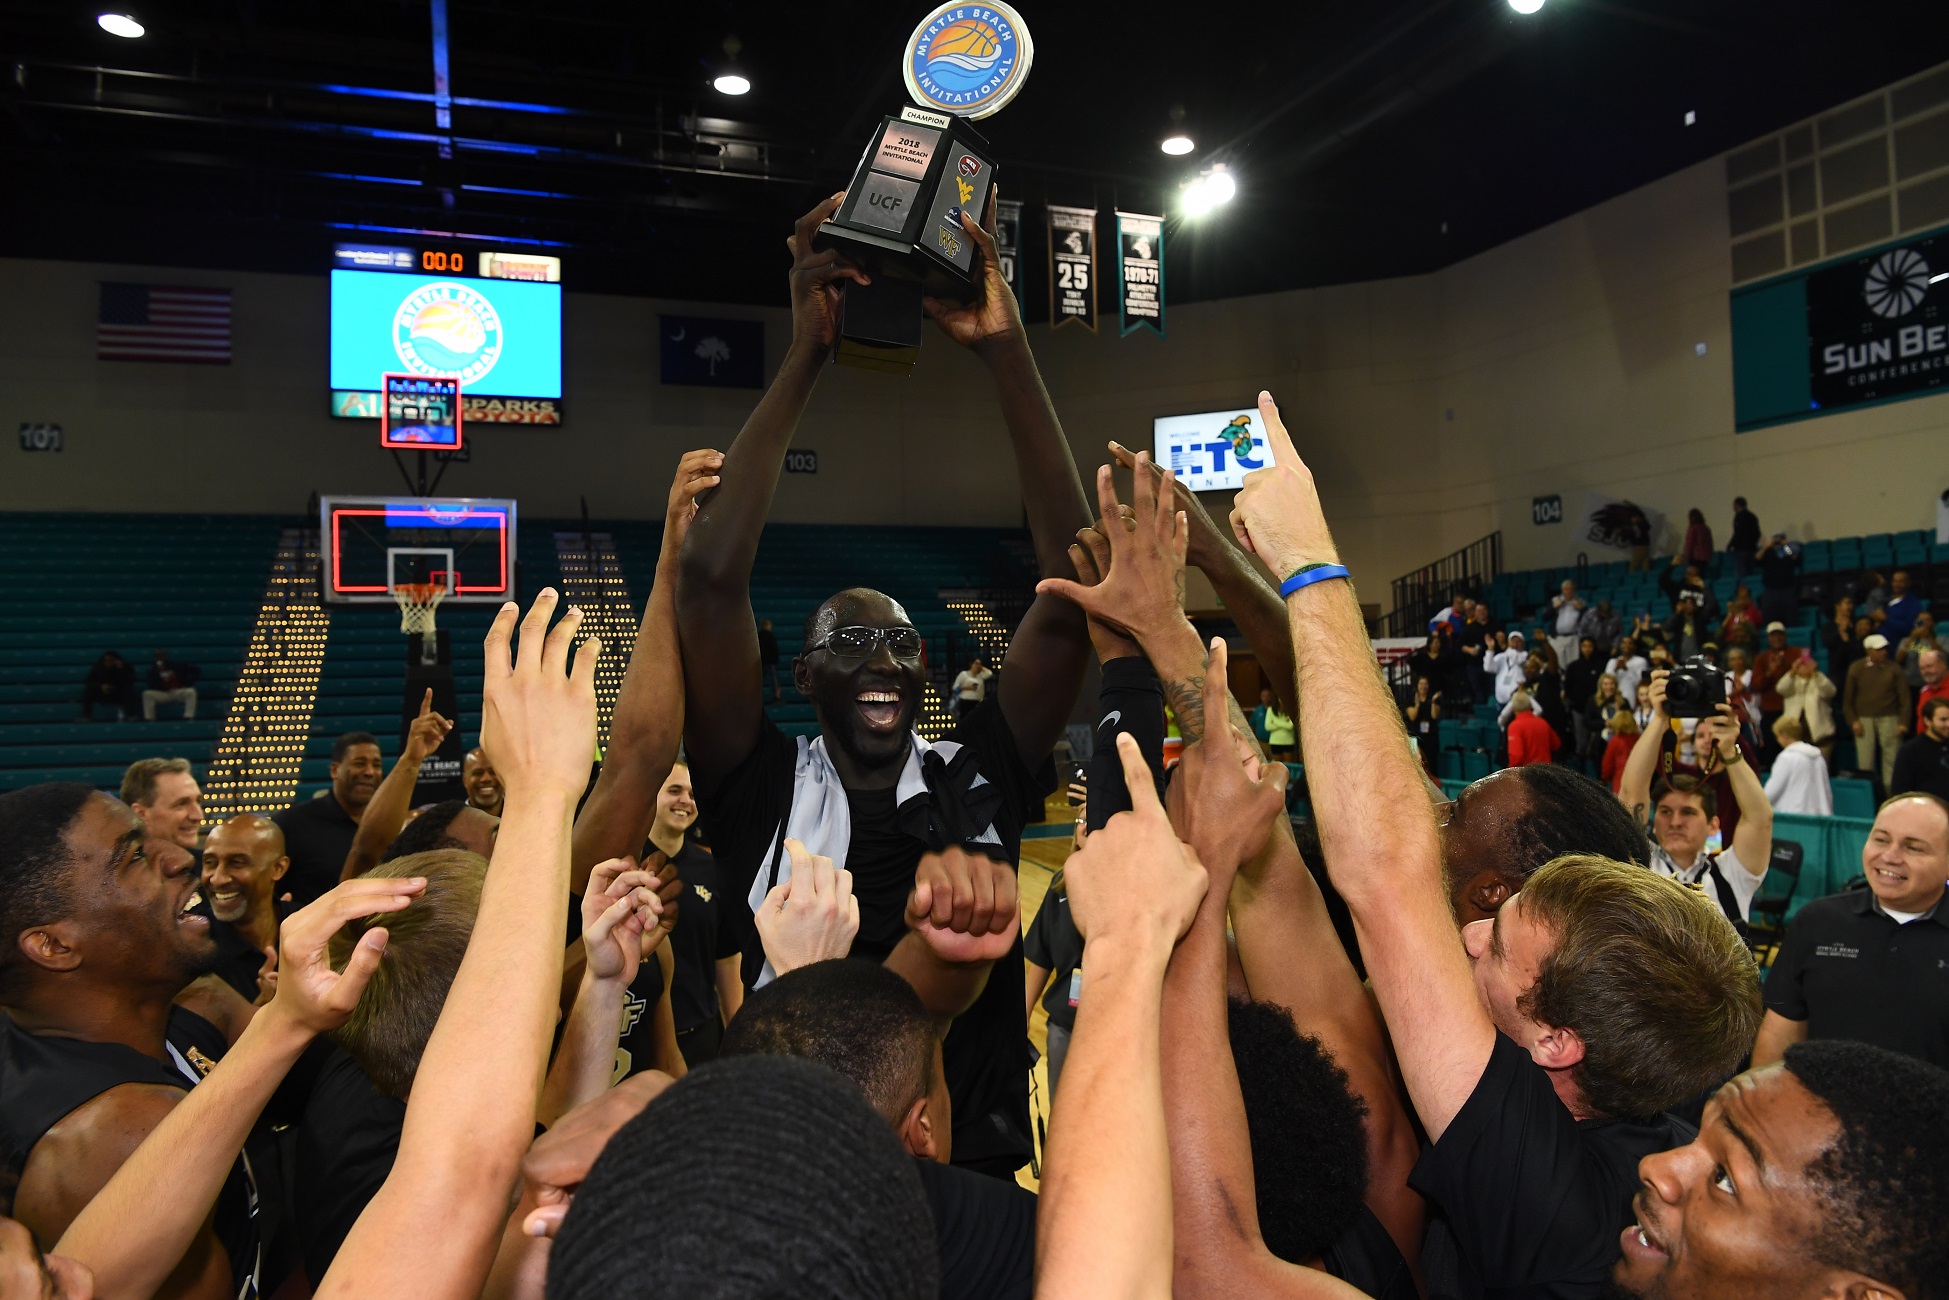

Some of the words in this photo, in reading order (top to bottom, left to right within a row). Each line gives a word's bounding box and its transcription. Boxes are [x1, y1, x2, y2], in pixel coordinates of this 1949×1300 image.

[917, 10, 964, 56] MYRTLE
[973, 9, 1012, 42] BEACH
[918, 58, 1012, 102] INVITATIONAL
[907, 111, 945, 126] CHAMPION
[884, 144, 908, 154] MYRTLE
[908, 149, 928, 158] BEACH
[898, 137, 920, 148] 2018
[882, 151, 924, 165] INVITATIONAL
[868, 192, 903, 211] UCF
[1058, 262, 1088, 290] 25
[1124, 266, 1159, 284] 1970-71
[400, 288, 450, 328] MYRTLE
[456, 290, 496, 331] BEACH
[1823, 338, 1892, 375] SUN
[1899, 324, 1949, 358] BE
[20, 429, 59, 448] 101
[787, 454, 815, 470] 103
[1535, 500, 1560, 521] 104
